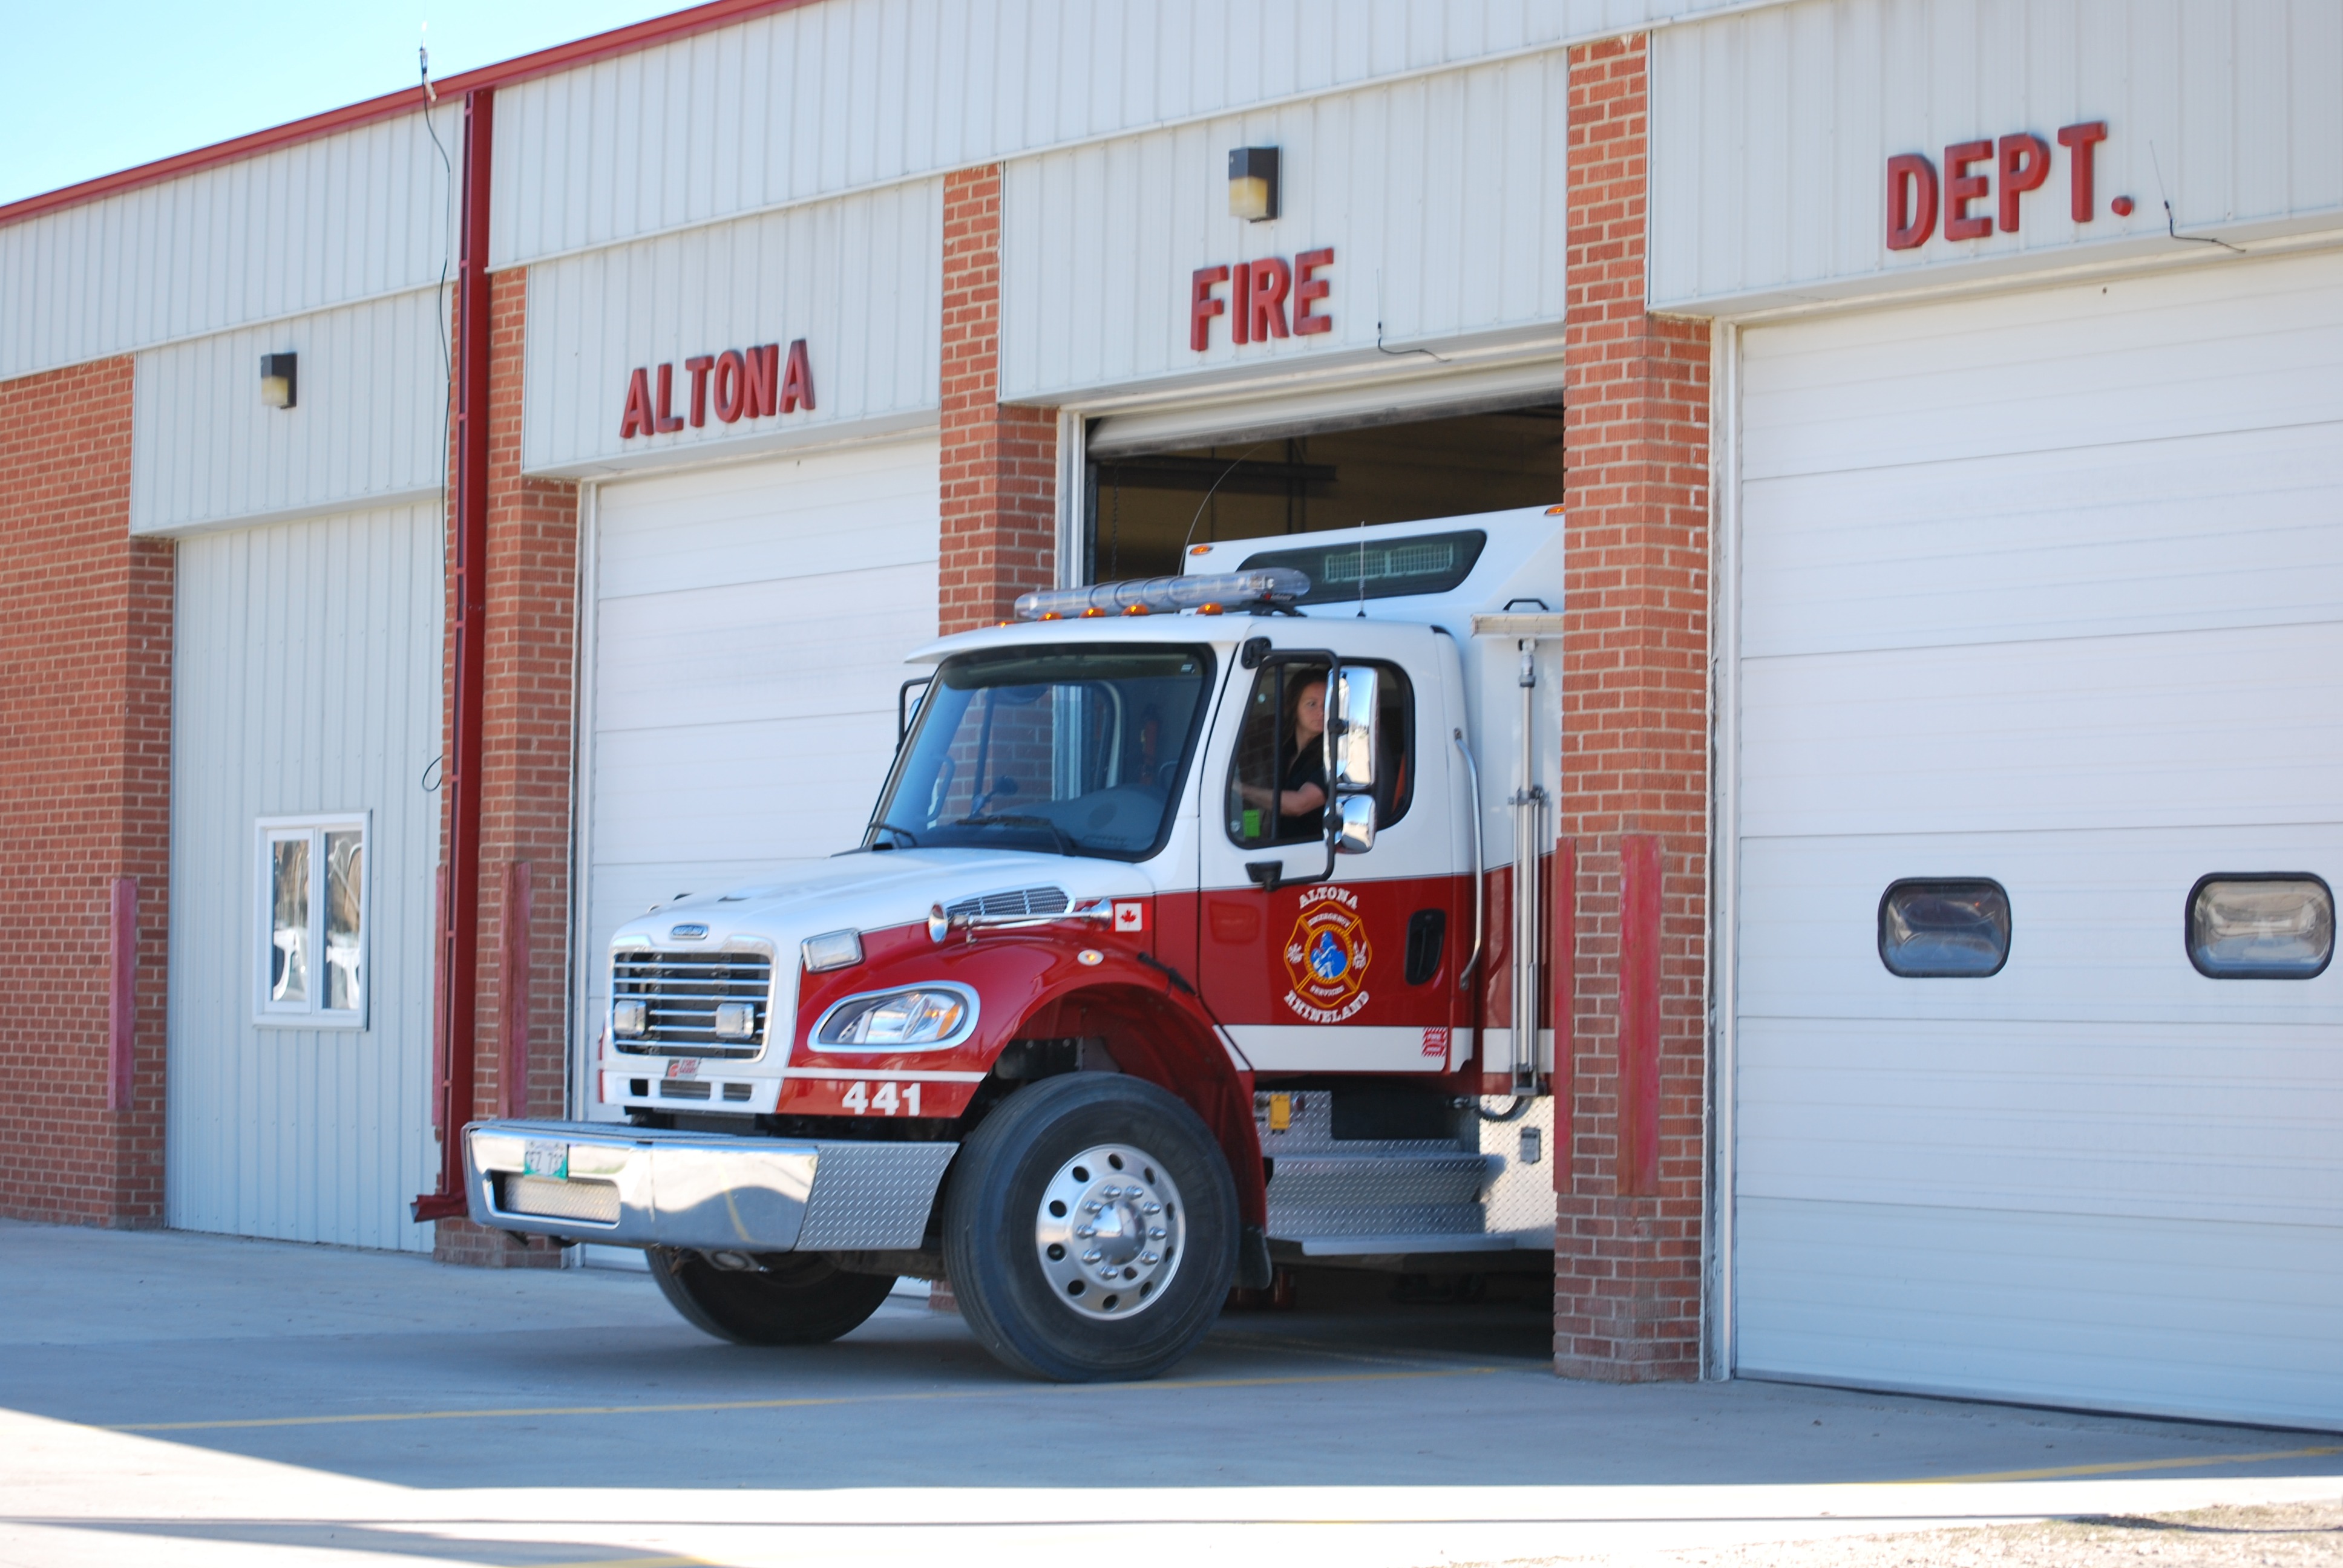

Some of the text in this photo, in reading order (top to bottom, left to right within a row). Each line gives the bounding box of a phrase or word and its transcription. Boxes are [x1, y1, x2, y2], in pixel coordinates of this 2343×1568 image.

[1886, 120, 2134, 250] DEPT.
[1190, 246, 1334, 352] FIRE
[620, 338, 816, 439] ALTONA
[1299, 886, 1358, 910] ALTONA
[1284, 990, 1369, 1024] RHINELAND
[842, 1081, 920, 1116] 441
